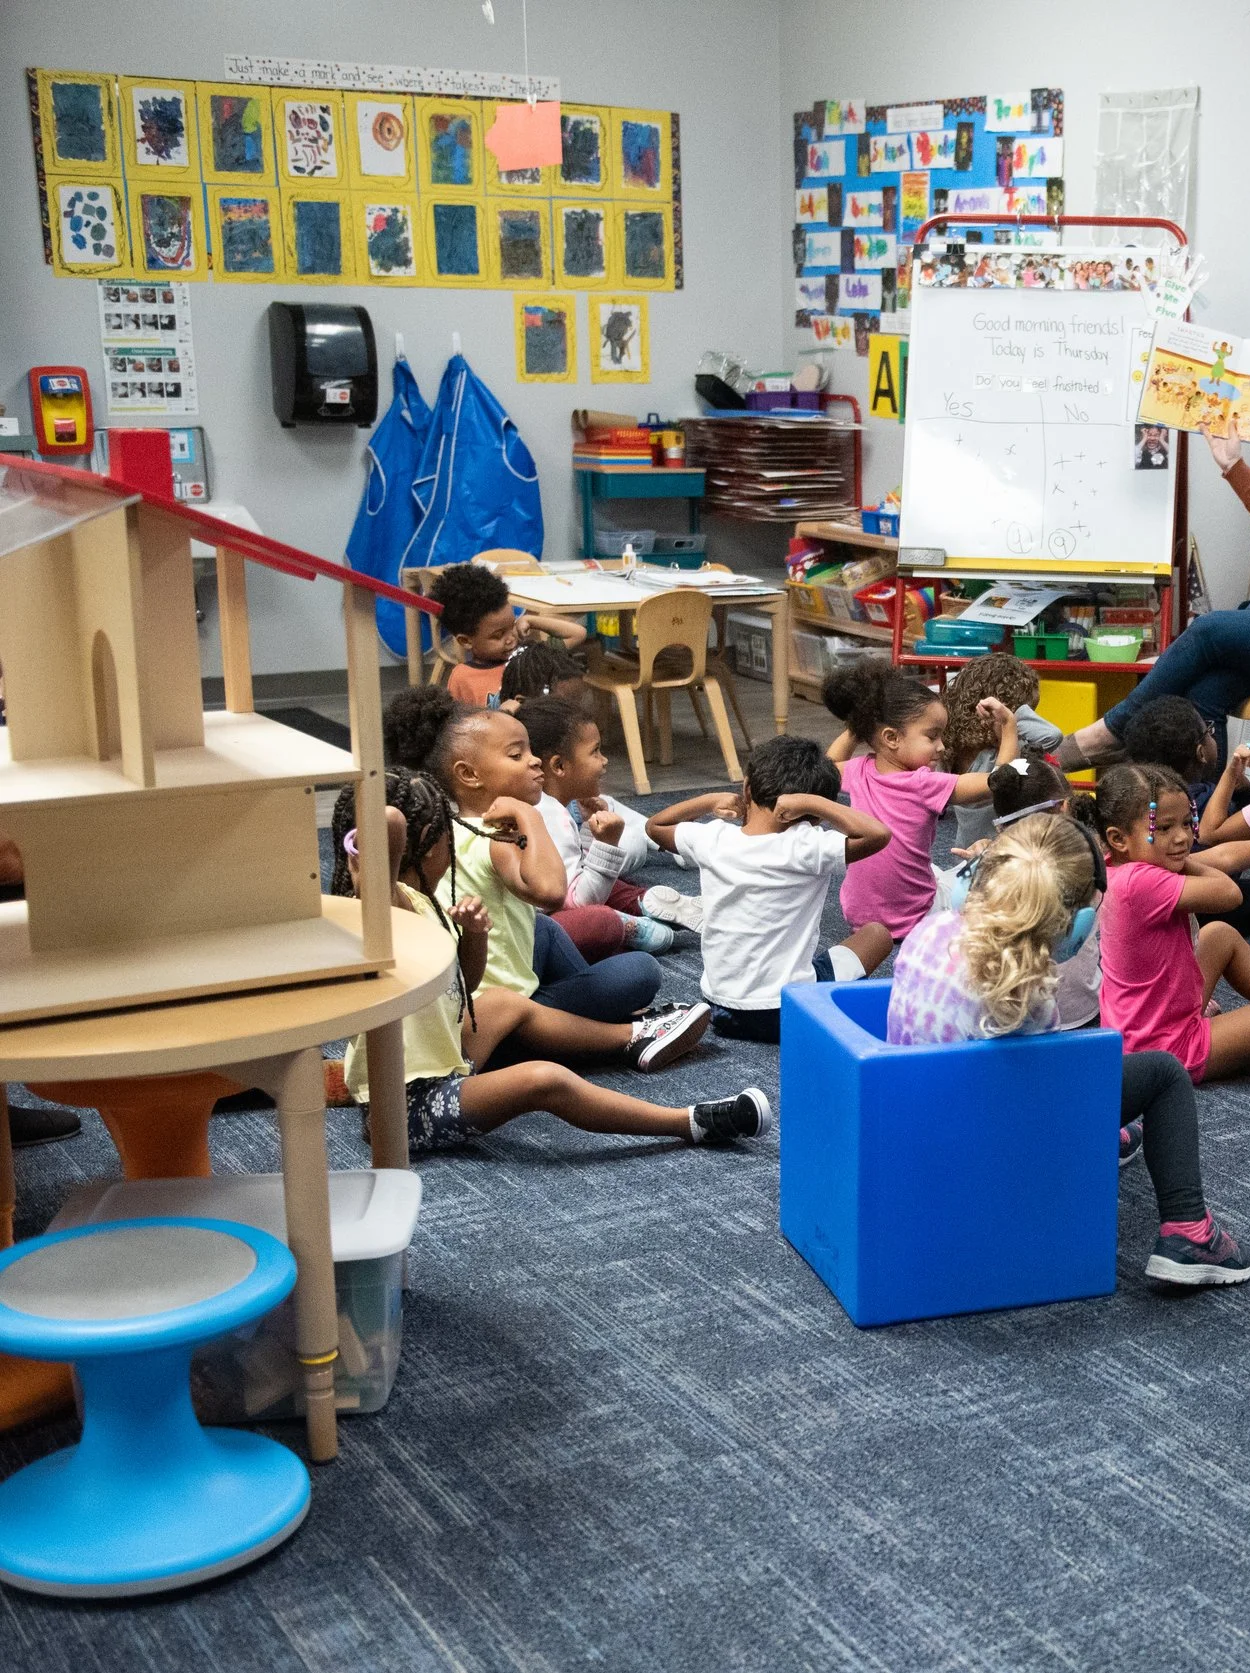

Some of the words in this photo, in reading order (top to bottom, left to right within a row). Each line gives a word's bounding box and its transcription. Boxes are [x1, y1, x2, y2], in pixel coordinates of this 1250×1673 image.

[226, 57, 253, 74] Just
[262, 62, 290, 77] make
[311, 66, 336, 80] mark
[342, 69, 361, 82] and
[367, 74, 384, 84] see
[395, 75, 424, 88] where
[451, 78, 480, 91] takes
[488, 82, 501, 94] you
[1163, 293, 1180, 305] Me
[1164, 279, 1188, 293] Give
[972, 312, 1011, 332] Good
[1015, 317, 1067, 339] morning
[1067, 313, 1125, 336] friends!
[1155, 305, 1178, 319] Five
[983, 336, 1027, 365] Today
[1033, 342, 1046, 359] is
[1052, 340, 1110, 366] Thursday
[871, 350, 898, 414] A
[975, 375, 992, 387] Do
[999, 377, 1021, 389] you
[1052, 375, 1100, 394] frustrated
[943, 392, 974, 418] Yes
[1063, 402, 1090, 423] No
